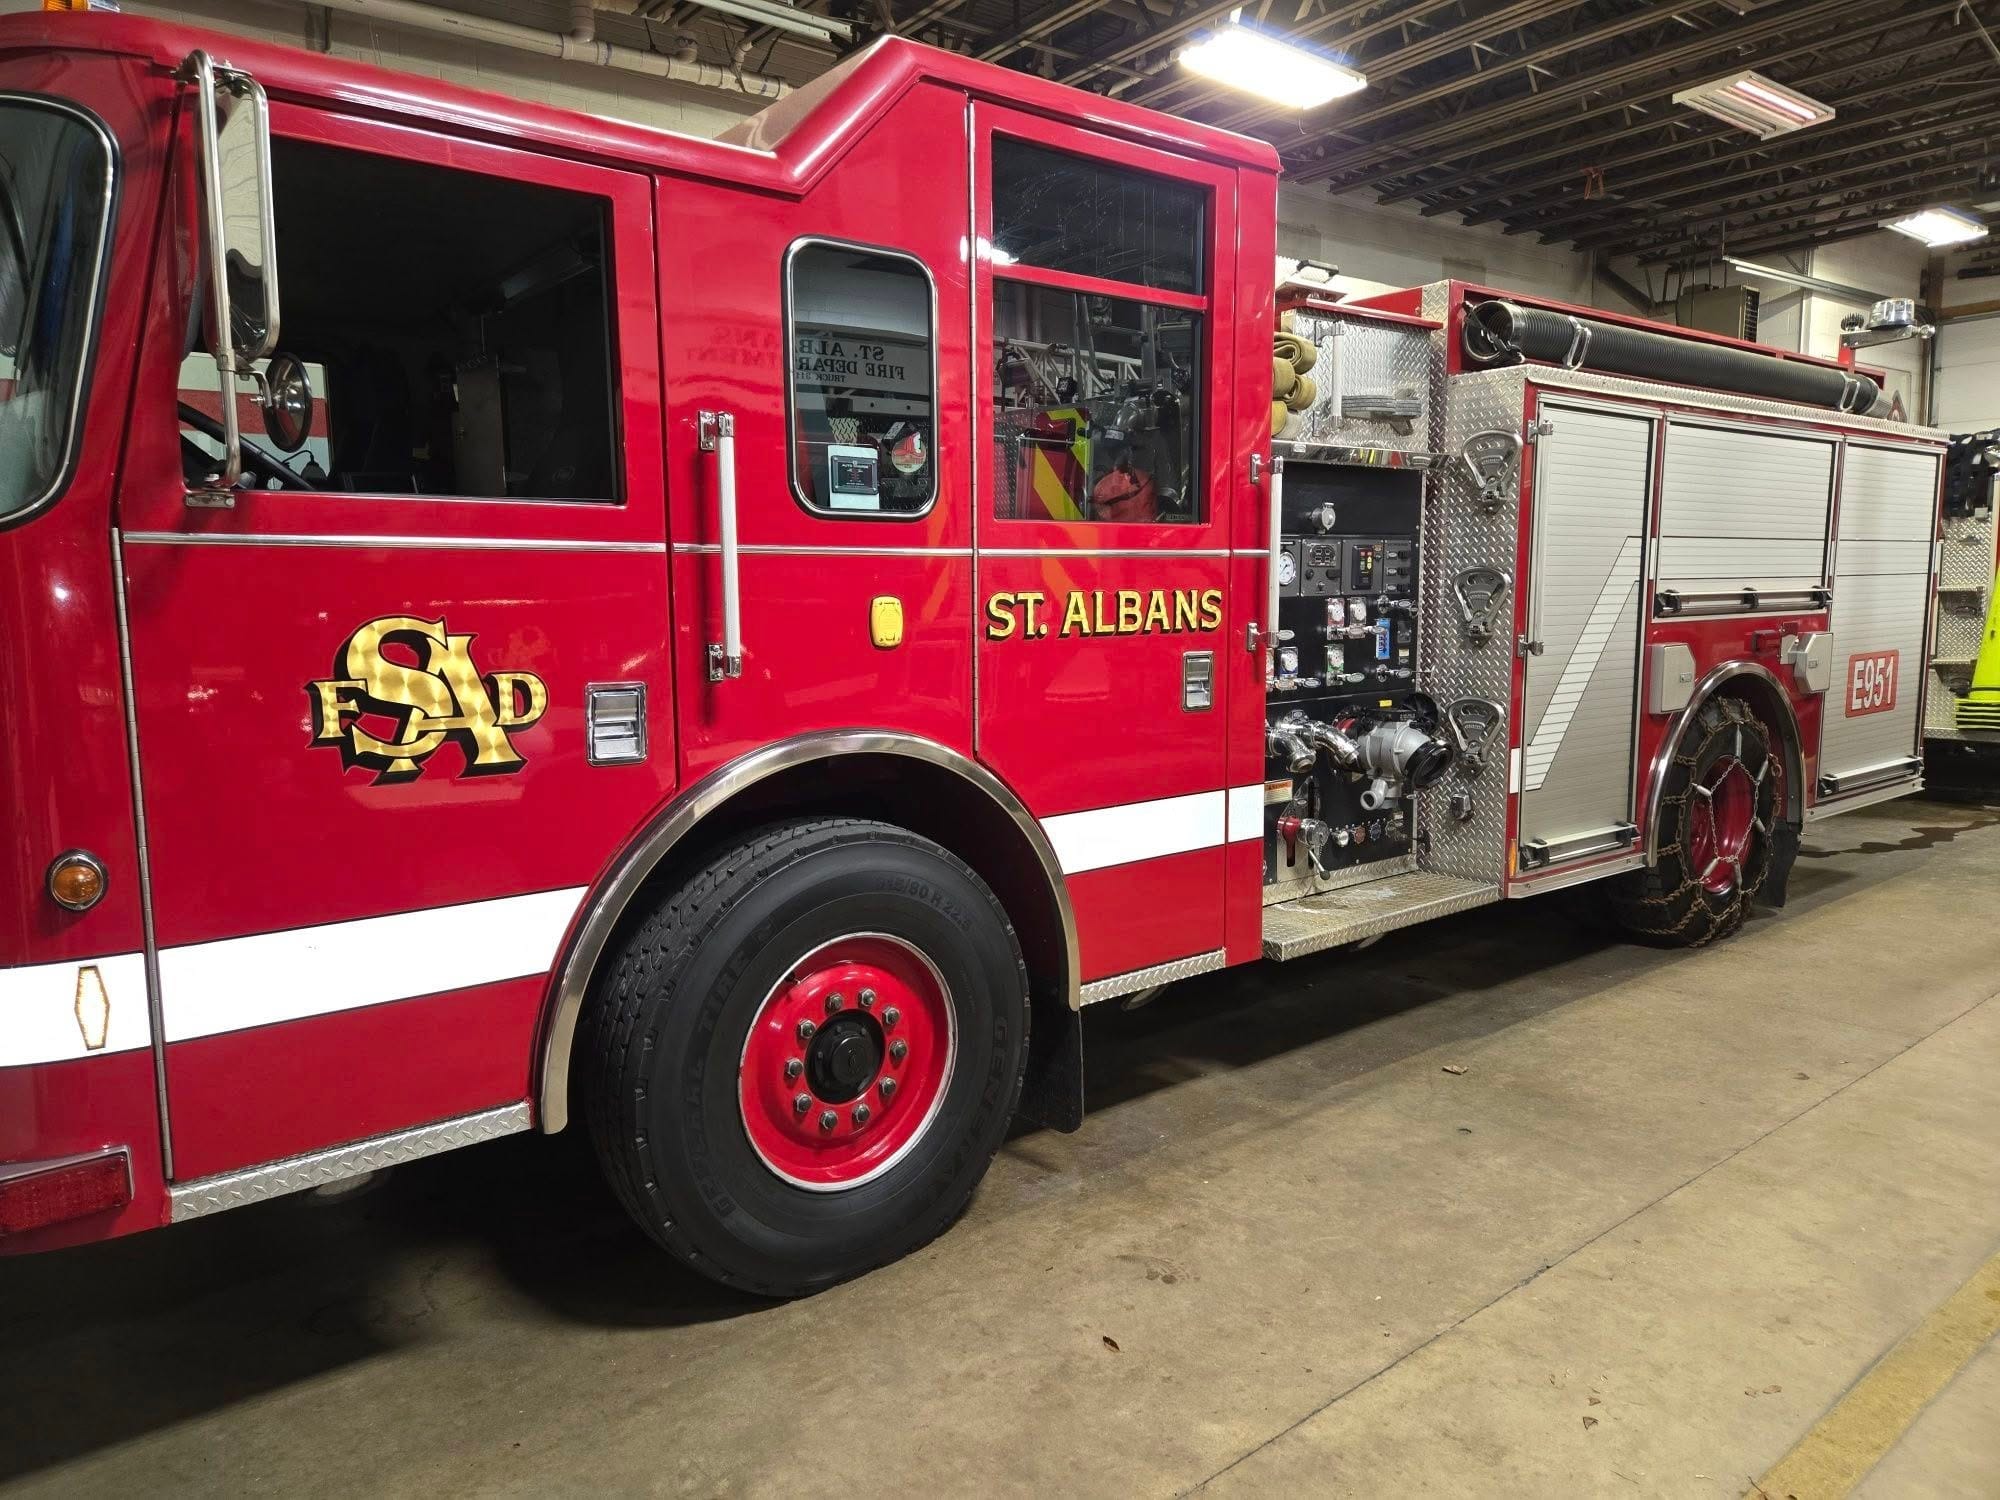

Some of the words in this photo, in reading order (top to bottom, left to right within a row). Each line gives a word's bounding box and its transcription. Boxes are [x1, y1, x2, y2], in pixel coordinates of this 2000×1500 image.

[985, 591, 1048, 641] ST.
[1058, 589, 1222, 639] ALBANS
[1851, 656, 1894, 710] E951
